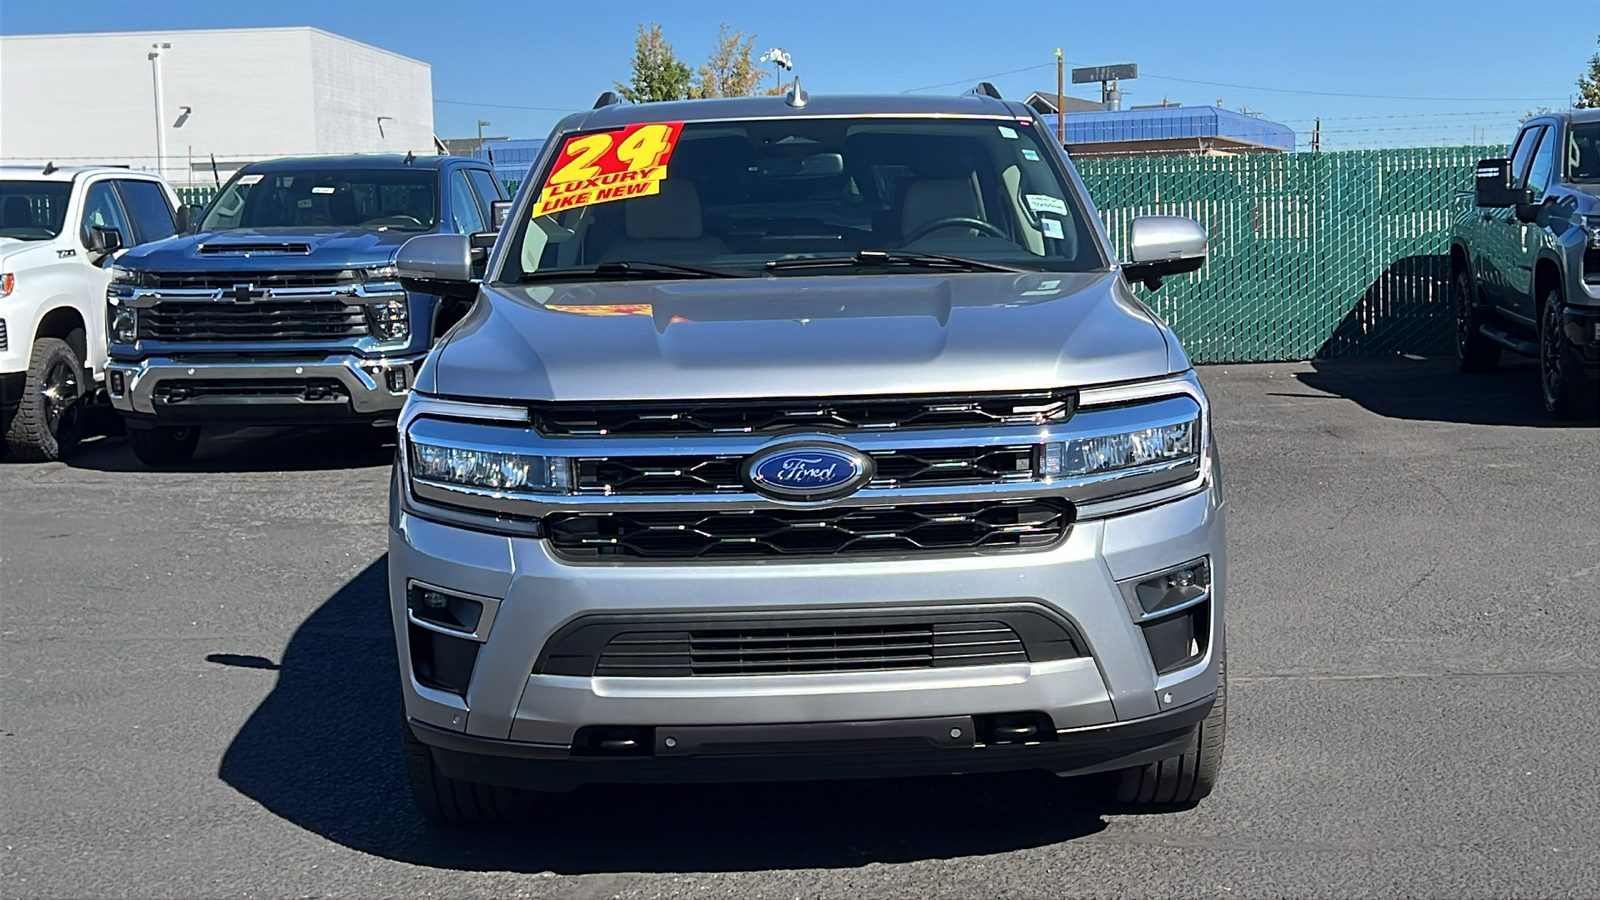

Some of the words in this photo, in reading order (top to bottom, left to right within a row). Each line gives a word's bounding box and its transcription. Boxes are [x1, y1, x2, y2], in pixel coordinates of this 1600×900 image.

[550, 125, 672, 185] 24
[541, 192, 591, 213] LIKE
[596, 182, 652, 201] NEW
[550, 168, 658, 197] LUXURY
[777, 458, 837, 482] Ford
